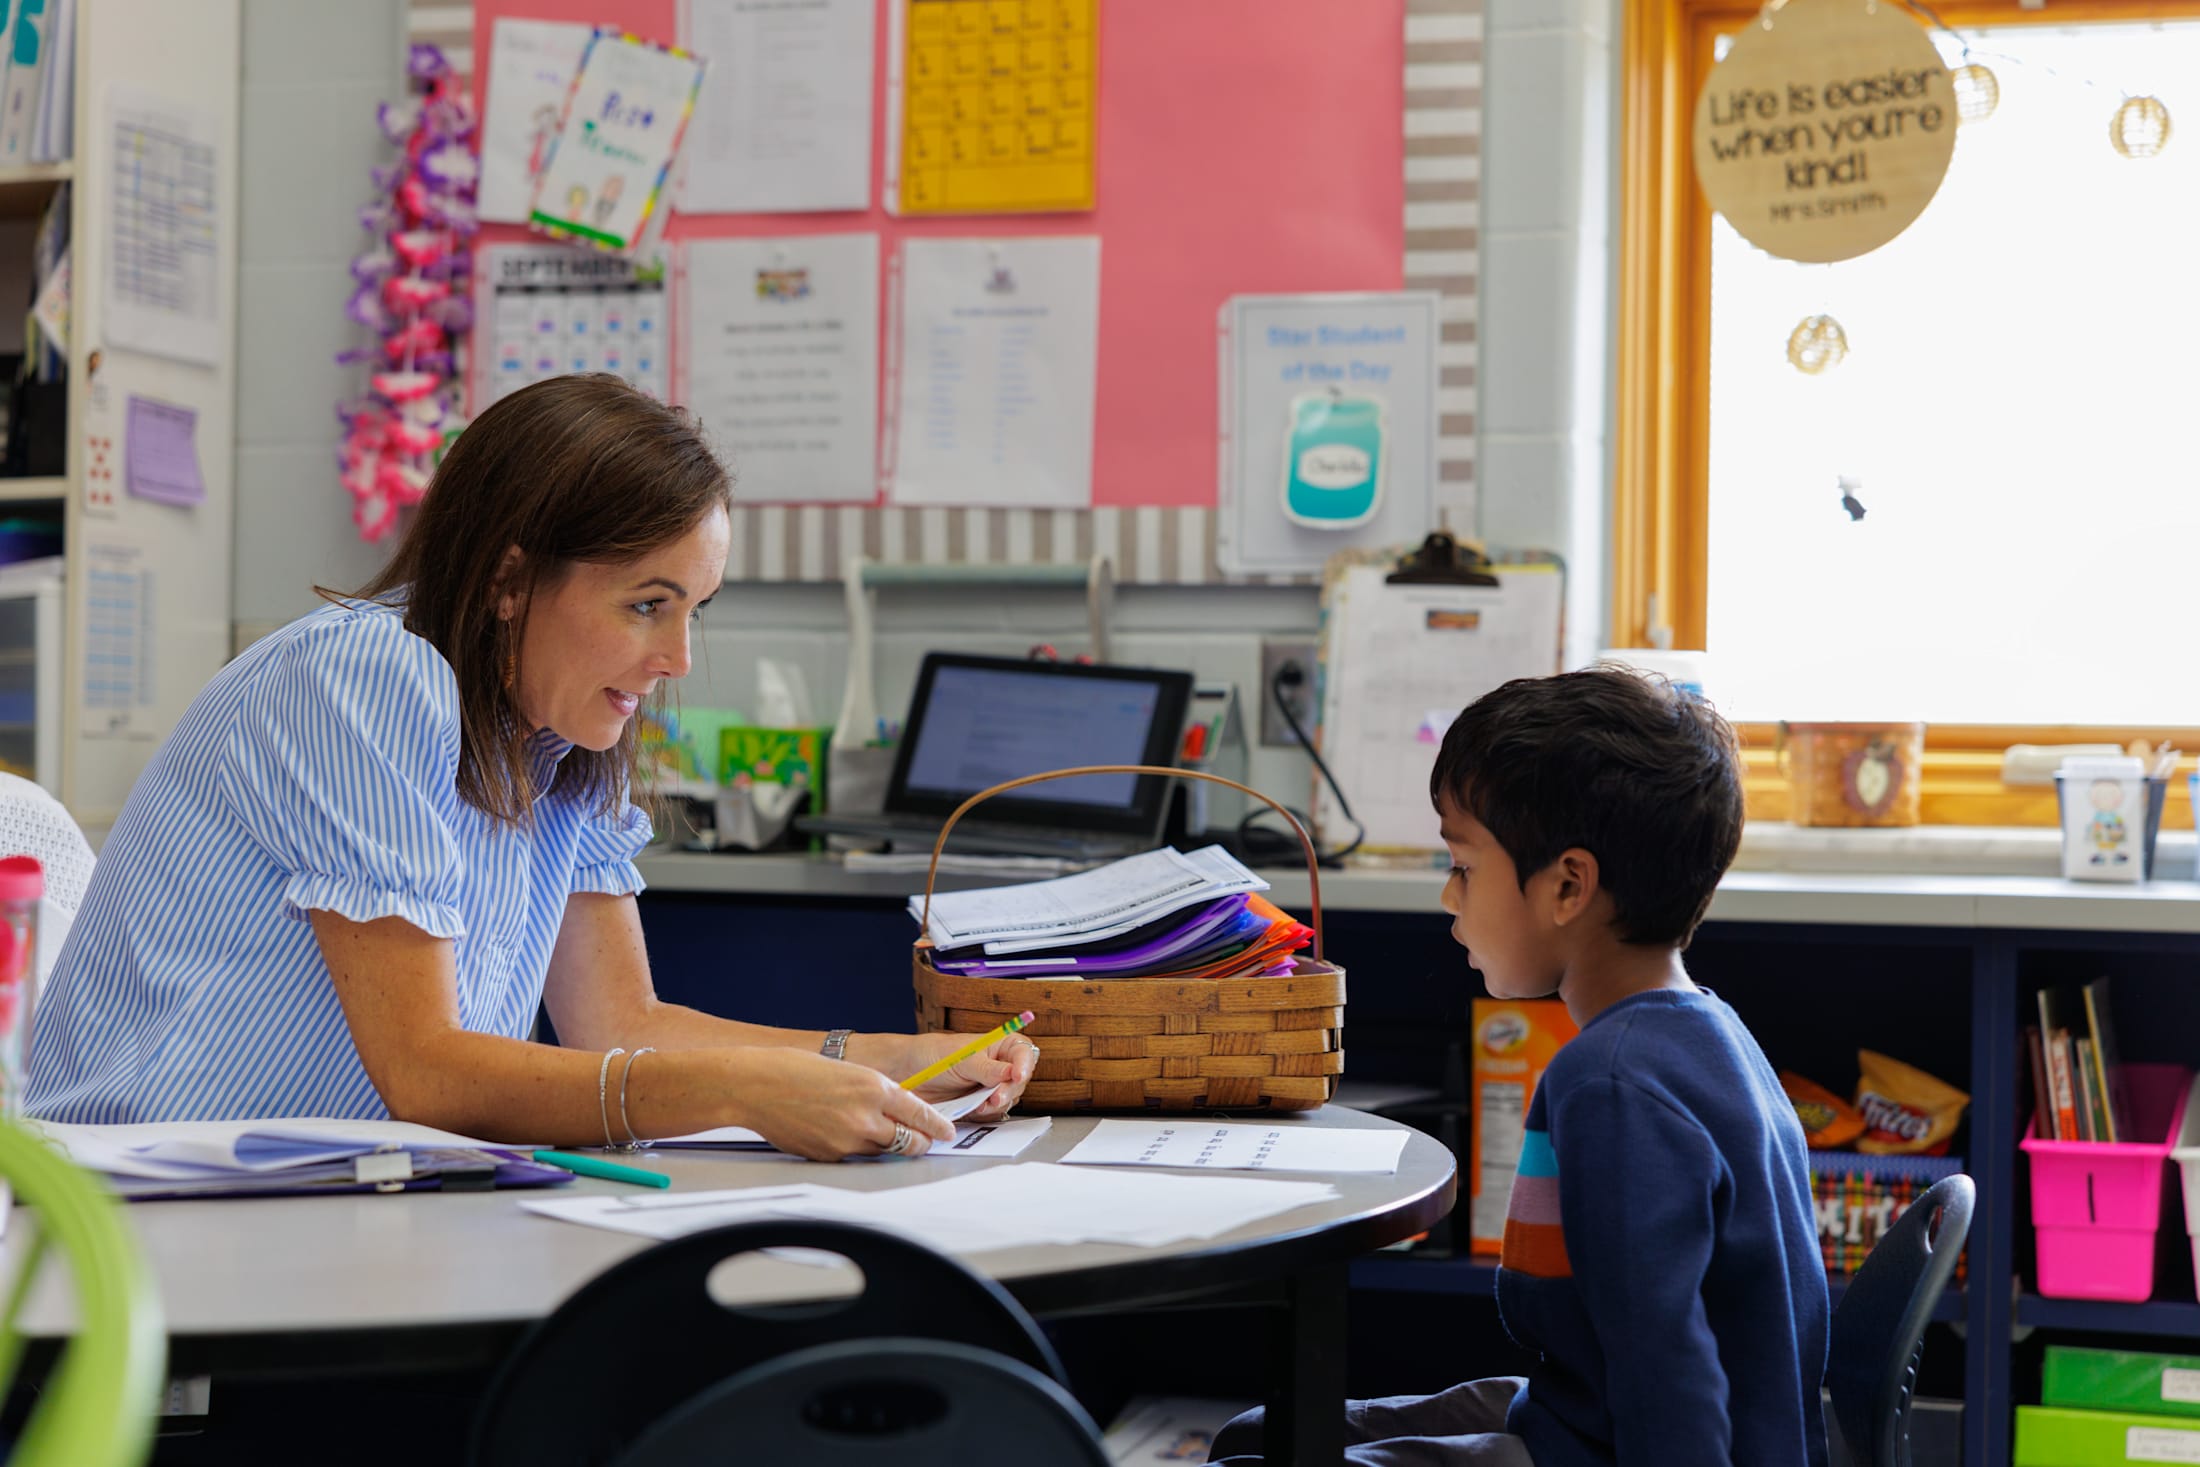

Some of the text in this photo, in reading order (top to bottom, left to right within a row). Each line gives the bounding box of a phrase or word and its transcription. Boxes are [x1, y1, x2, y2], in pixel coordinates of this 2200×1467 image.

[1710, 67, 1942, 126] Life is easier
[1711, 123, 1814, 162] when
[1785, 151, 1868, 190] kind!
[502, 257, 630, 278] SEPTEMBER
[1267, 323, 1405, 347] Star Student
[1281, 361, 1392, 384] of the Day
[1857, 1090, 1932, 1142] Fritos
